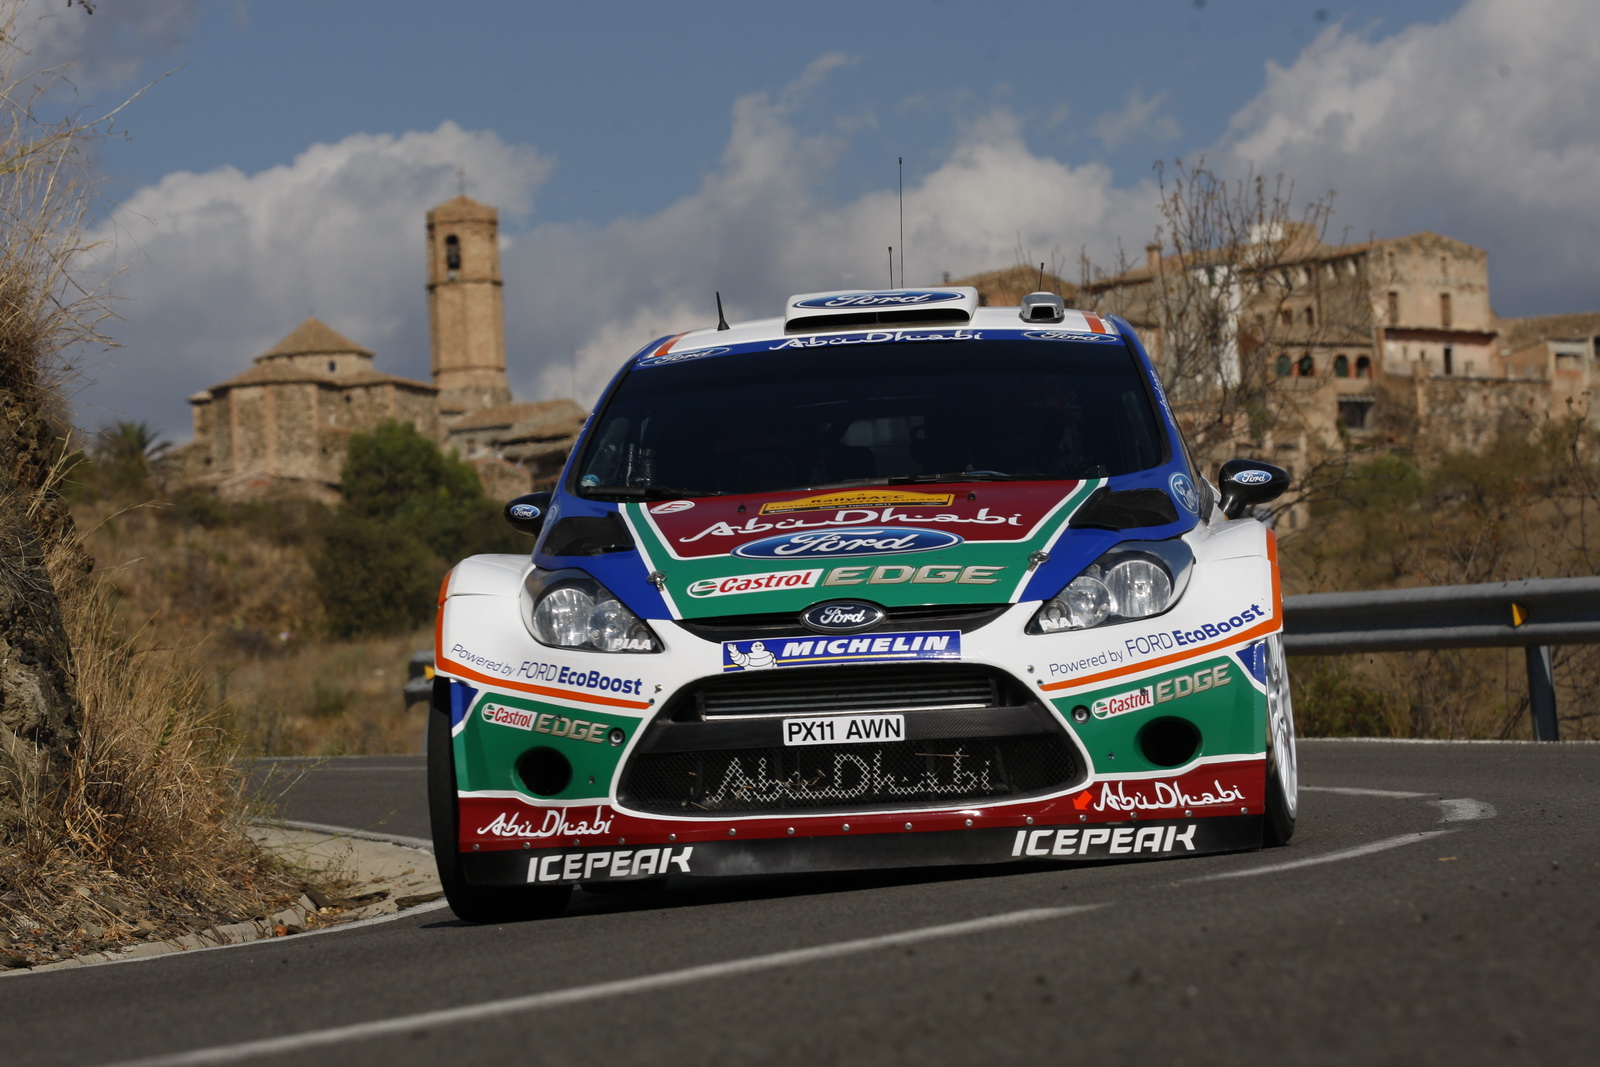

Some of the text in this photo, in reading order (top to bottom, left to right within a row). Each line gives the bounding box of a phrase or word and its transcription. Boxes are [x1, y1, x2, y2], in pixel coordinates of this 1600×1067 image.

[825, 292, 929, 307] Ford
[1241, 472, 1266, 483] Ford
[513, 505, 533, 518] Ford
[773, 529, 921, 556] Ford
[718, 565, 1007, 593] Castrol EDGE
[819, 606, 865, 626] Ford
[1039, 615, 1086, 633] PIAA
[612, 638, 652, 650] PIAA
[781, 635, 951, 657] MICHELIN
[1048, 603, 1265, 677] Powered by FORD EcoBoost
[450, 643, 643, 696] Powered by FORD EcoBoost
[1109, 662, 1233, 715] Castrol EDGE
[494, 707, 611, 744] Castrol EDGE
[787, 718, 901, 742] PX11 AWN
[1011, 824, 1198, 857] ICEPEAK
[526, 846, 694, 883] ICEPEAK
